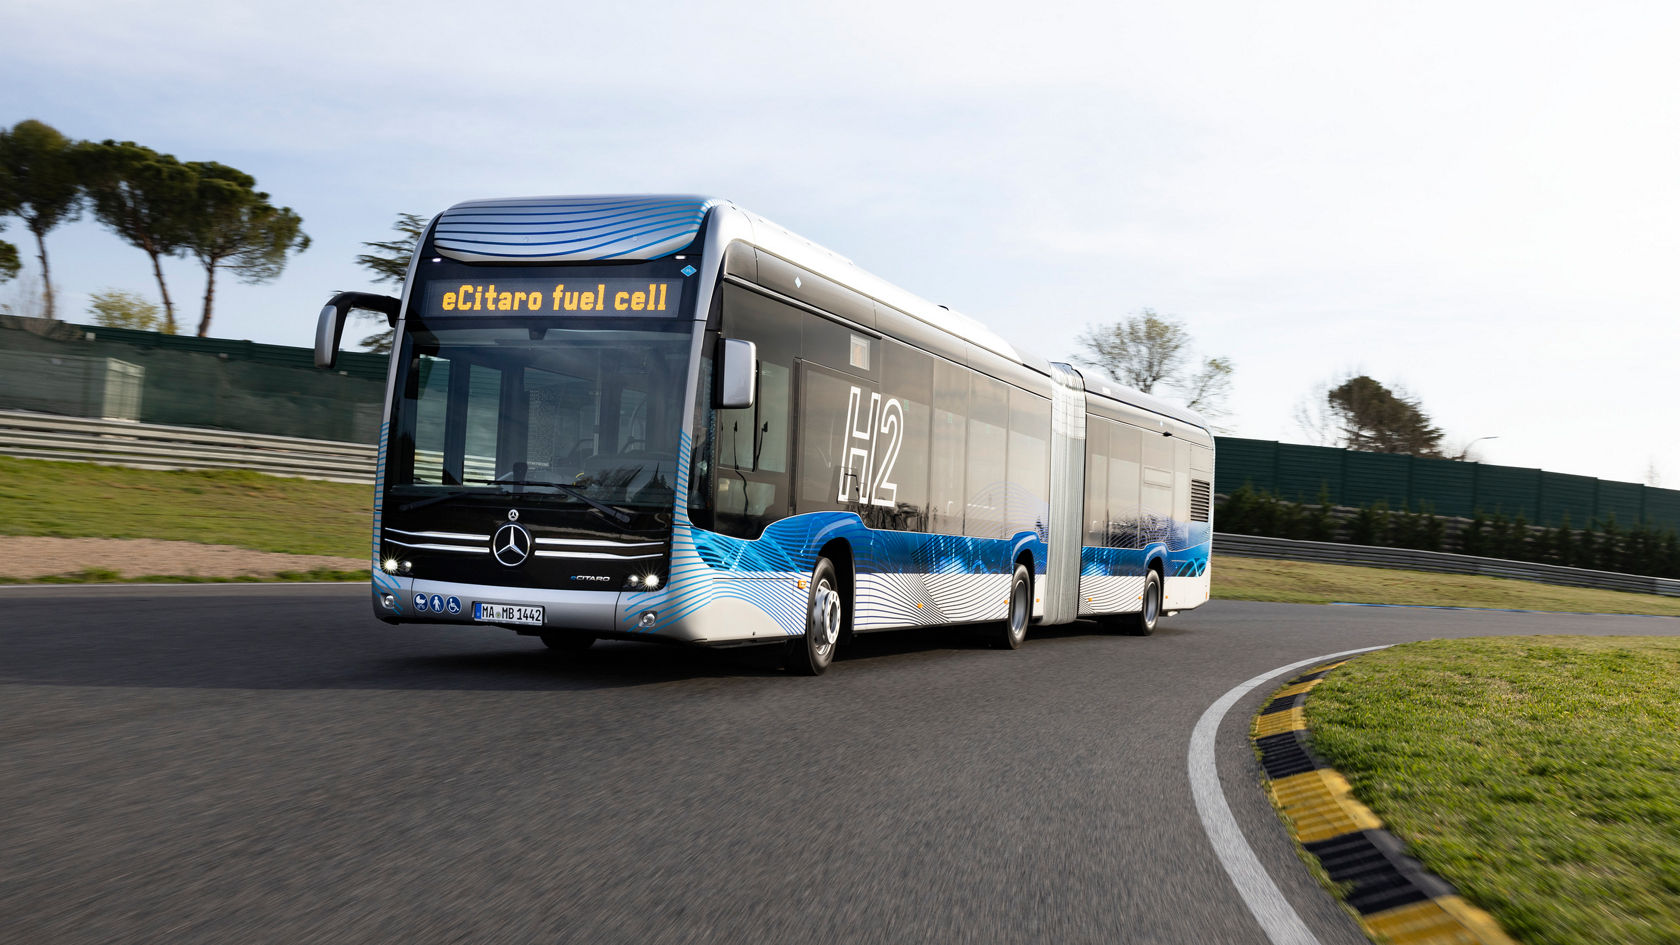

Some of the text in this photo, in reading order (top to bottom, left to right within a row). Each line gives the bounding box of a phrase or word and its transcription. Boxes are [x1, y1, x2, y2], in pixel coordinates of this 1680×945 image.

[442, 284, 668, 311] eCitaro fuel cell
[838, 386, 904, 507] H2
[482, 605, 495, 619] MA
[502, 607, 515, 620] MB
[517, 608, 542, 622] 1442
